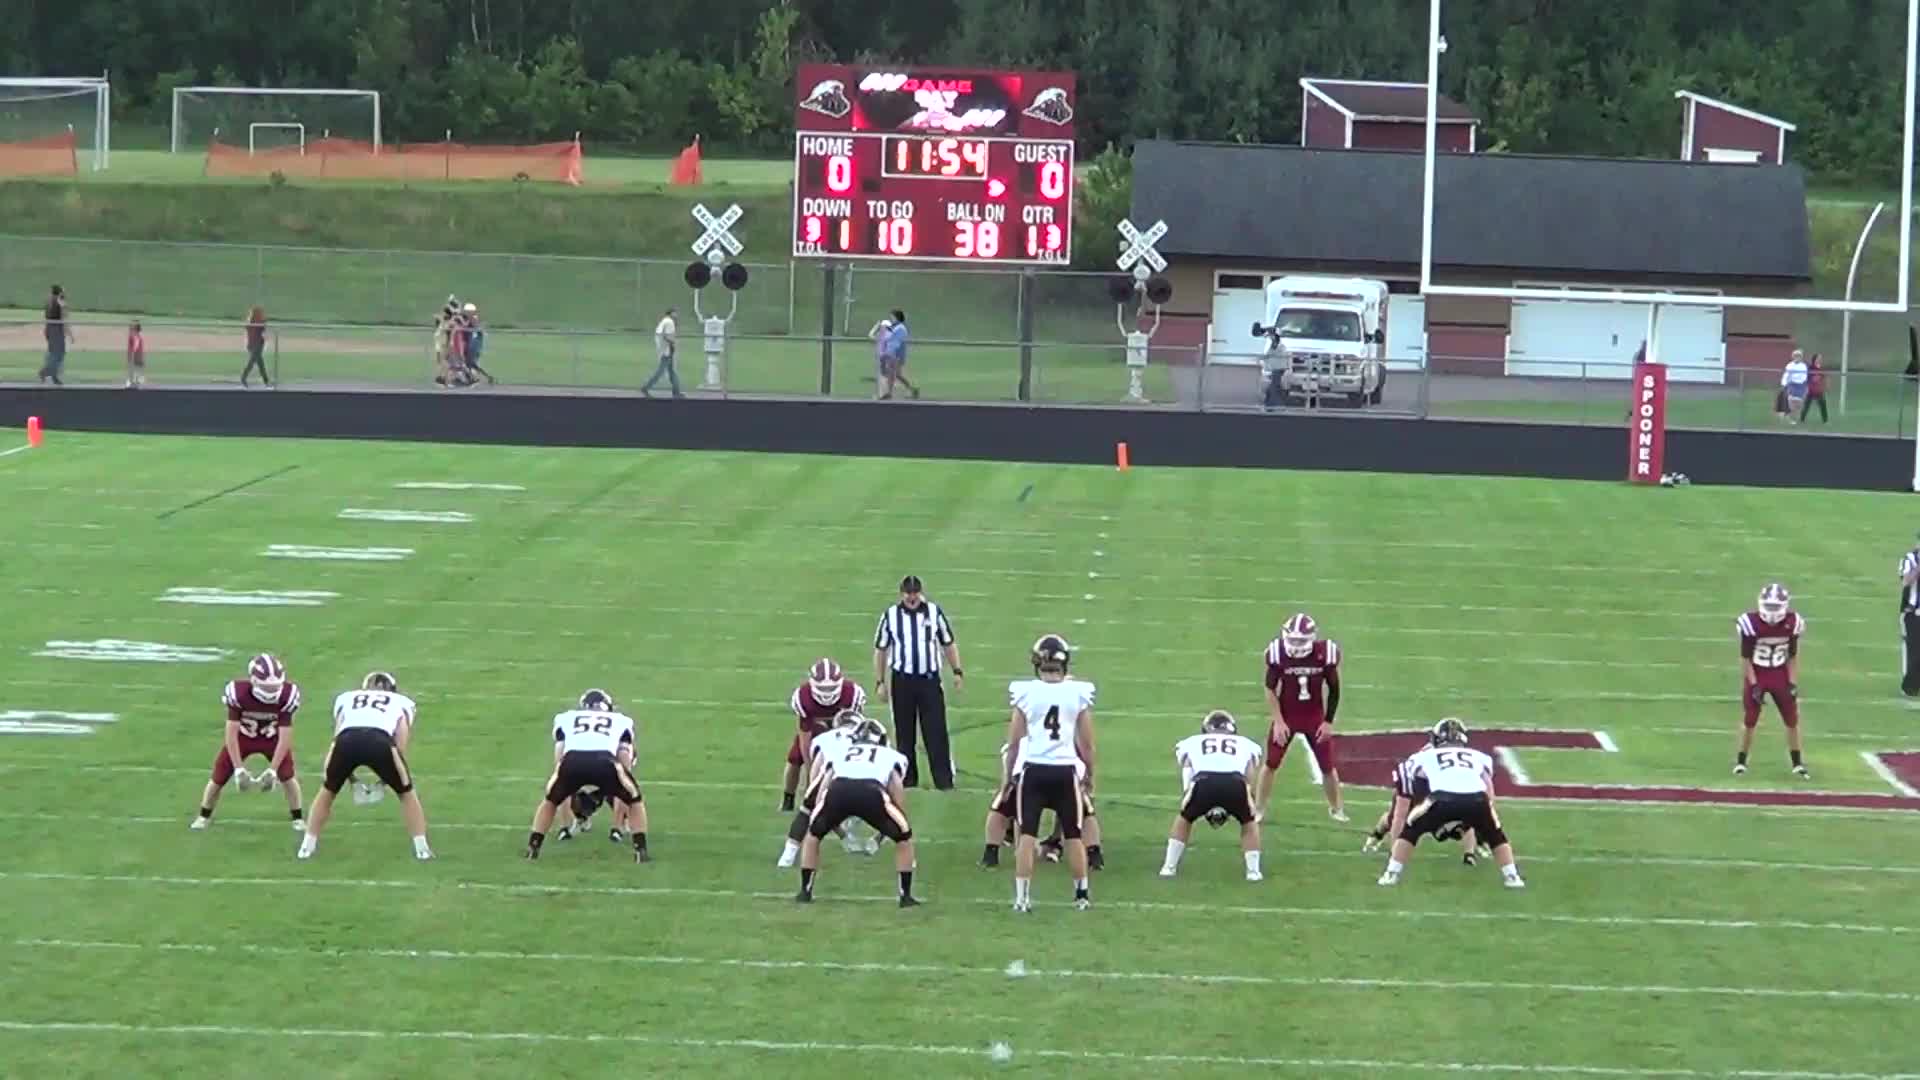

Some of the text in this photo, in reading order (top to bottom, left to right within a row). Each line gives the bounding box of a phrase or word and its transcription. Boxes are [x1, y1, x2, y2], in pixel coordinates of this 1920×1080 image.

[903, 79, 973, 92] GAME
[803, 137, 853, 156] HOME
[1015, 145, 1067, 163] GUEST
[897, 139, 986, 175] 11:54
[828, 156, 851, 191] 0
[1041, 162, 1064, 199] 0
[803, 198, 851, 217] DOWN
[867, 200, 914, 219] TO GO
[947, 203, 1005, 222] BALL ON
[1022, 205, 1054, 224] QTR
[840, 219, 850, 250] 1
[878, 218, 913, 254] 10
[954, 220, 999, 257] 38
[1638, 375, 1655, 475] SPOONER
[1297, 675, 1311, 700] 1
[351, 694, 391, 713] 82
[573, 715, 613, 737] 52
[1043, 704, 1061, 740] 4
[845, 746, 879, 764] 21
[1201, 738, 1238, 756] 66
[1436, 751, 1474, 771] 55
